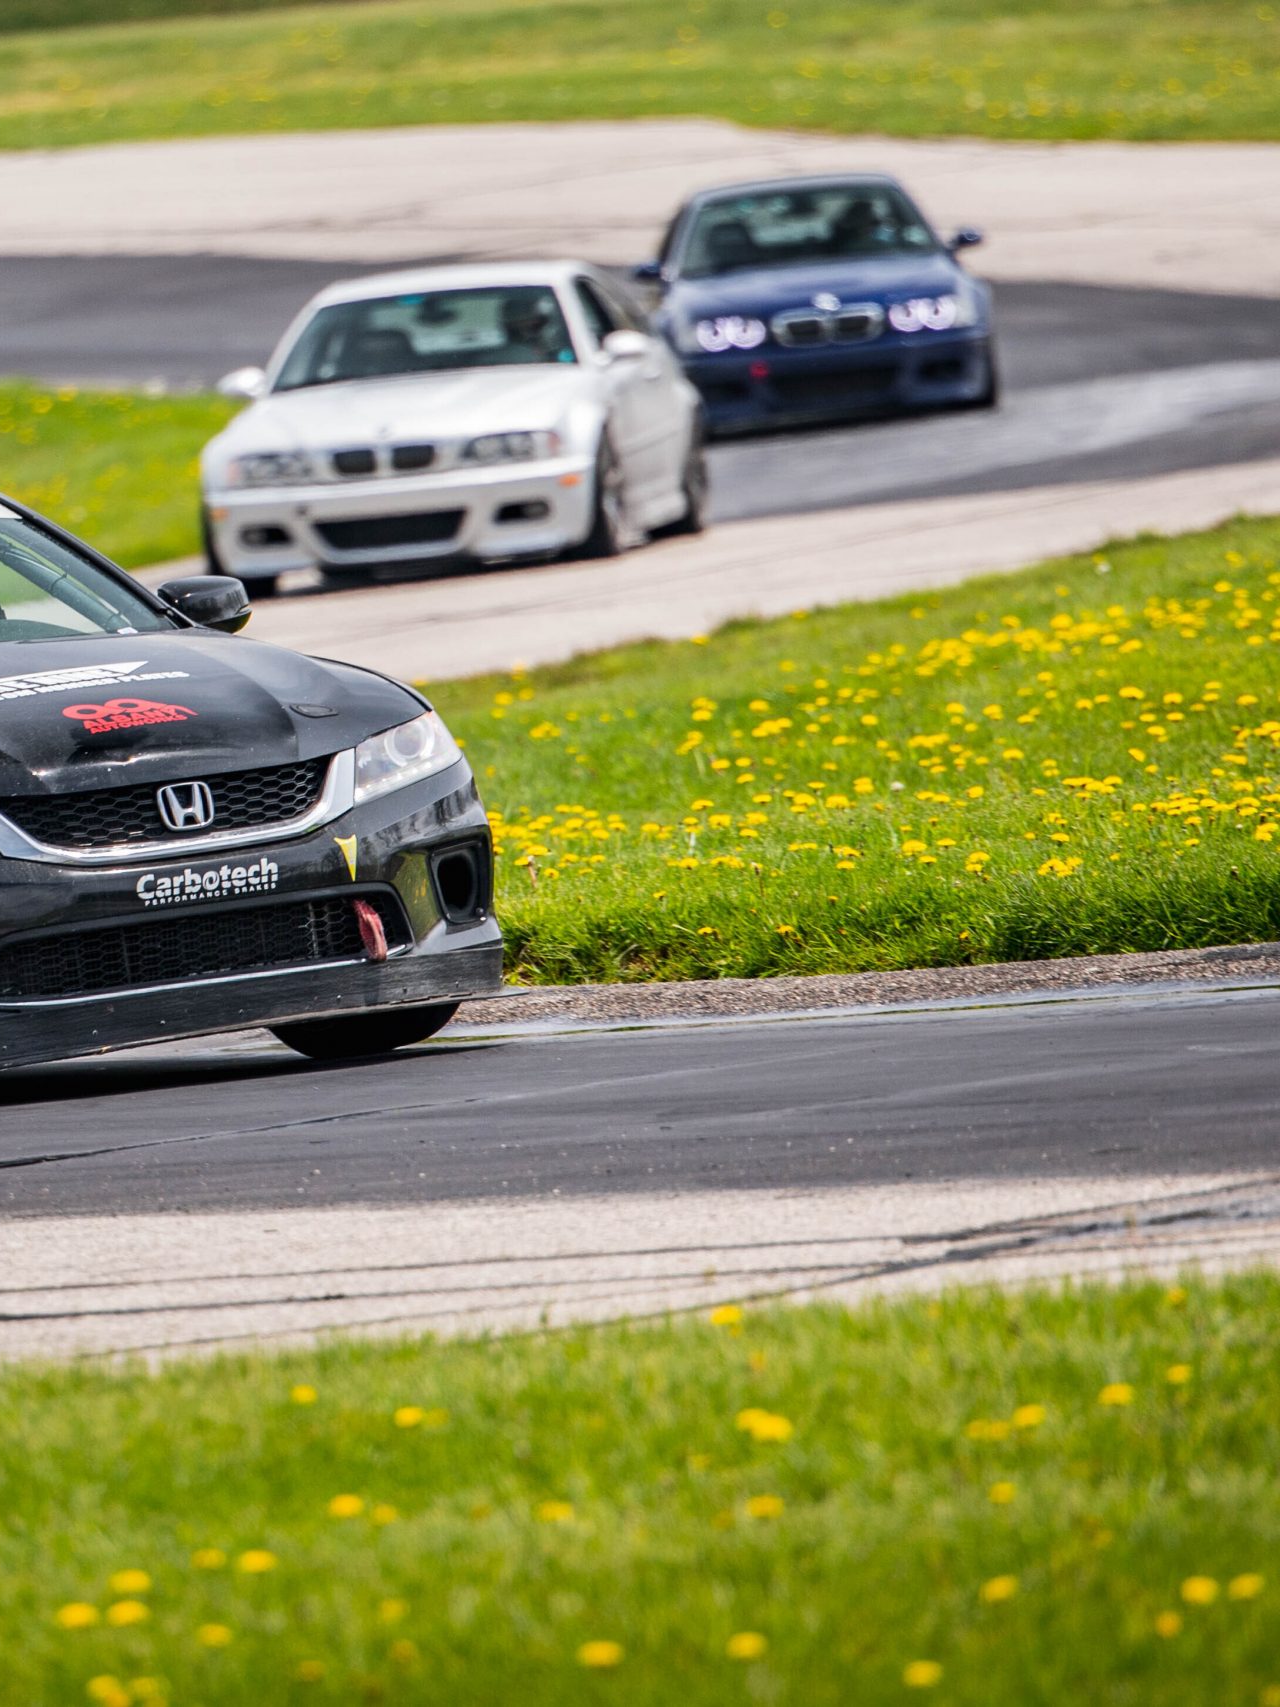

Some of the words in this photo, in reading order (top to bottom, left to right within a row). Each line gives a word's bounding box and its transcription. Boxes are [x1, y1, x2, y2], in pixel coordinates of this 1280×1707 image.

[136, 857, 279, 900] Carbotech
[144, 889, 228, 906] PERFORMANCE
[234, 882, 277, 896] BRAKES
